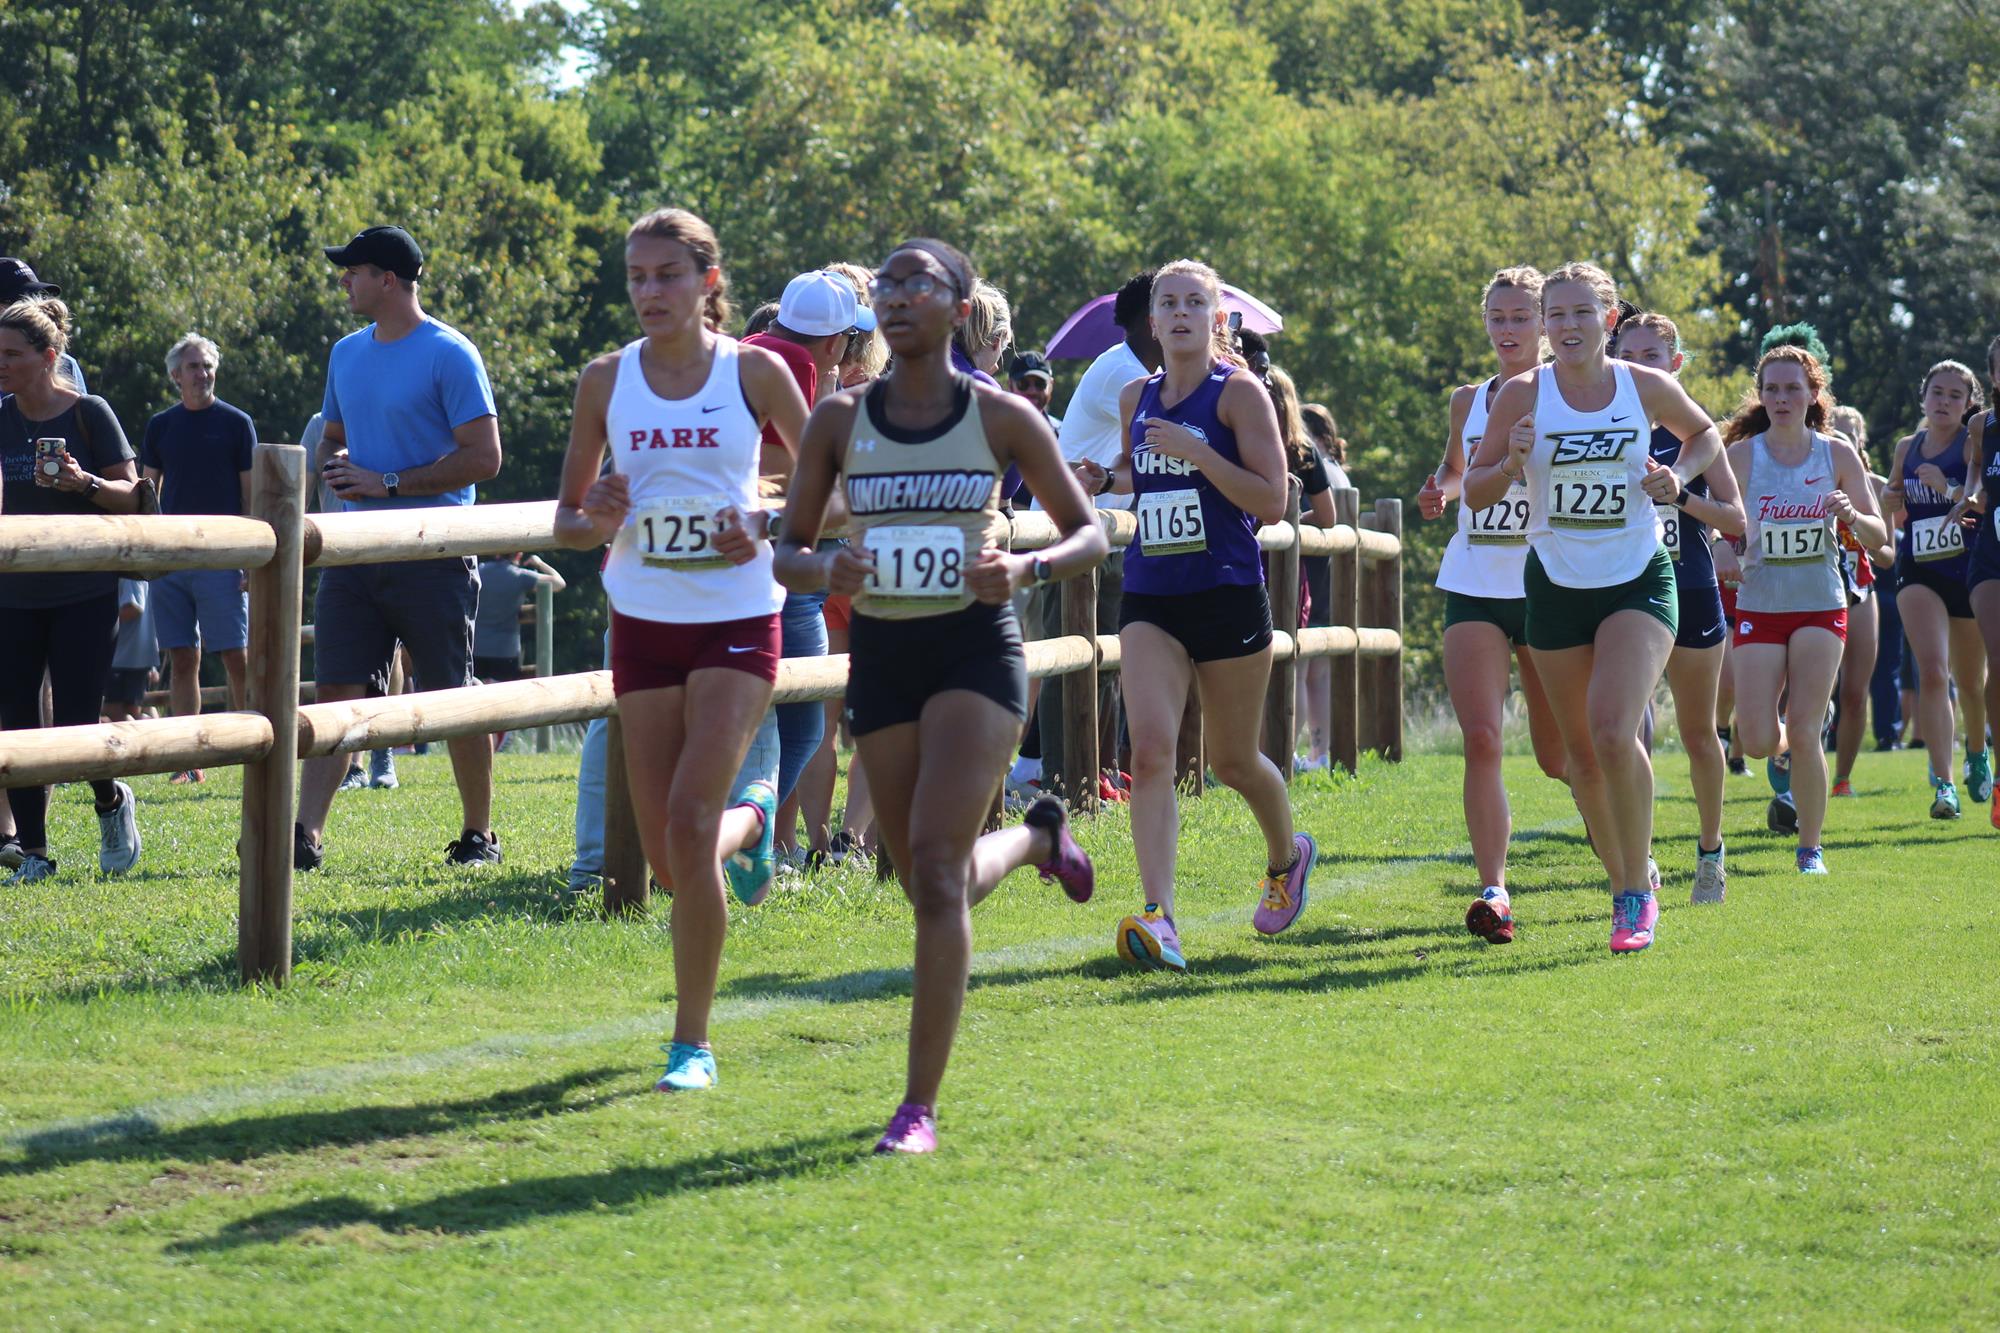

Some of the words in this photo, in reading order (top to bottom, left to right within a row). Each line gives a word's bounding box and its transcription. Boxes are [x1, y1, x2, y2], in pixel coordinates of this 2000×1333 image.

[630, 428, 720, 451] PARK
[1548, 430, 1637, 464] S&T
[848, 472, 995, 513] LINDENWOOD
[1554, 483, 1626, 515] 1225
[1758, 494, 1827, 521] Friends
[1141, 504, 1202, 540] 1165
[1472, 500, 1530, 530] 1229
[1765, 527, 1823, 555] 1157
[1915, 525, 1961, 552] 1266
